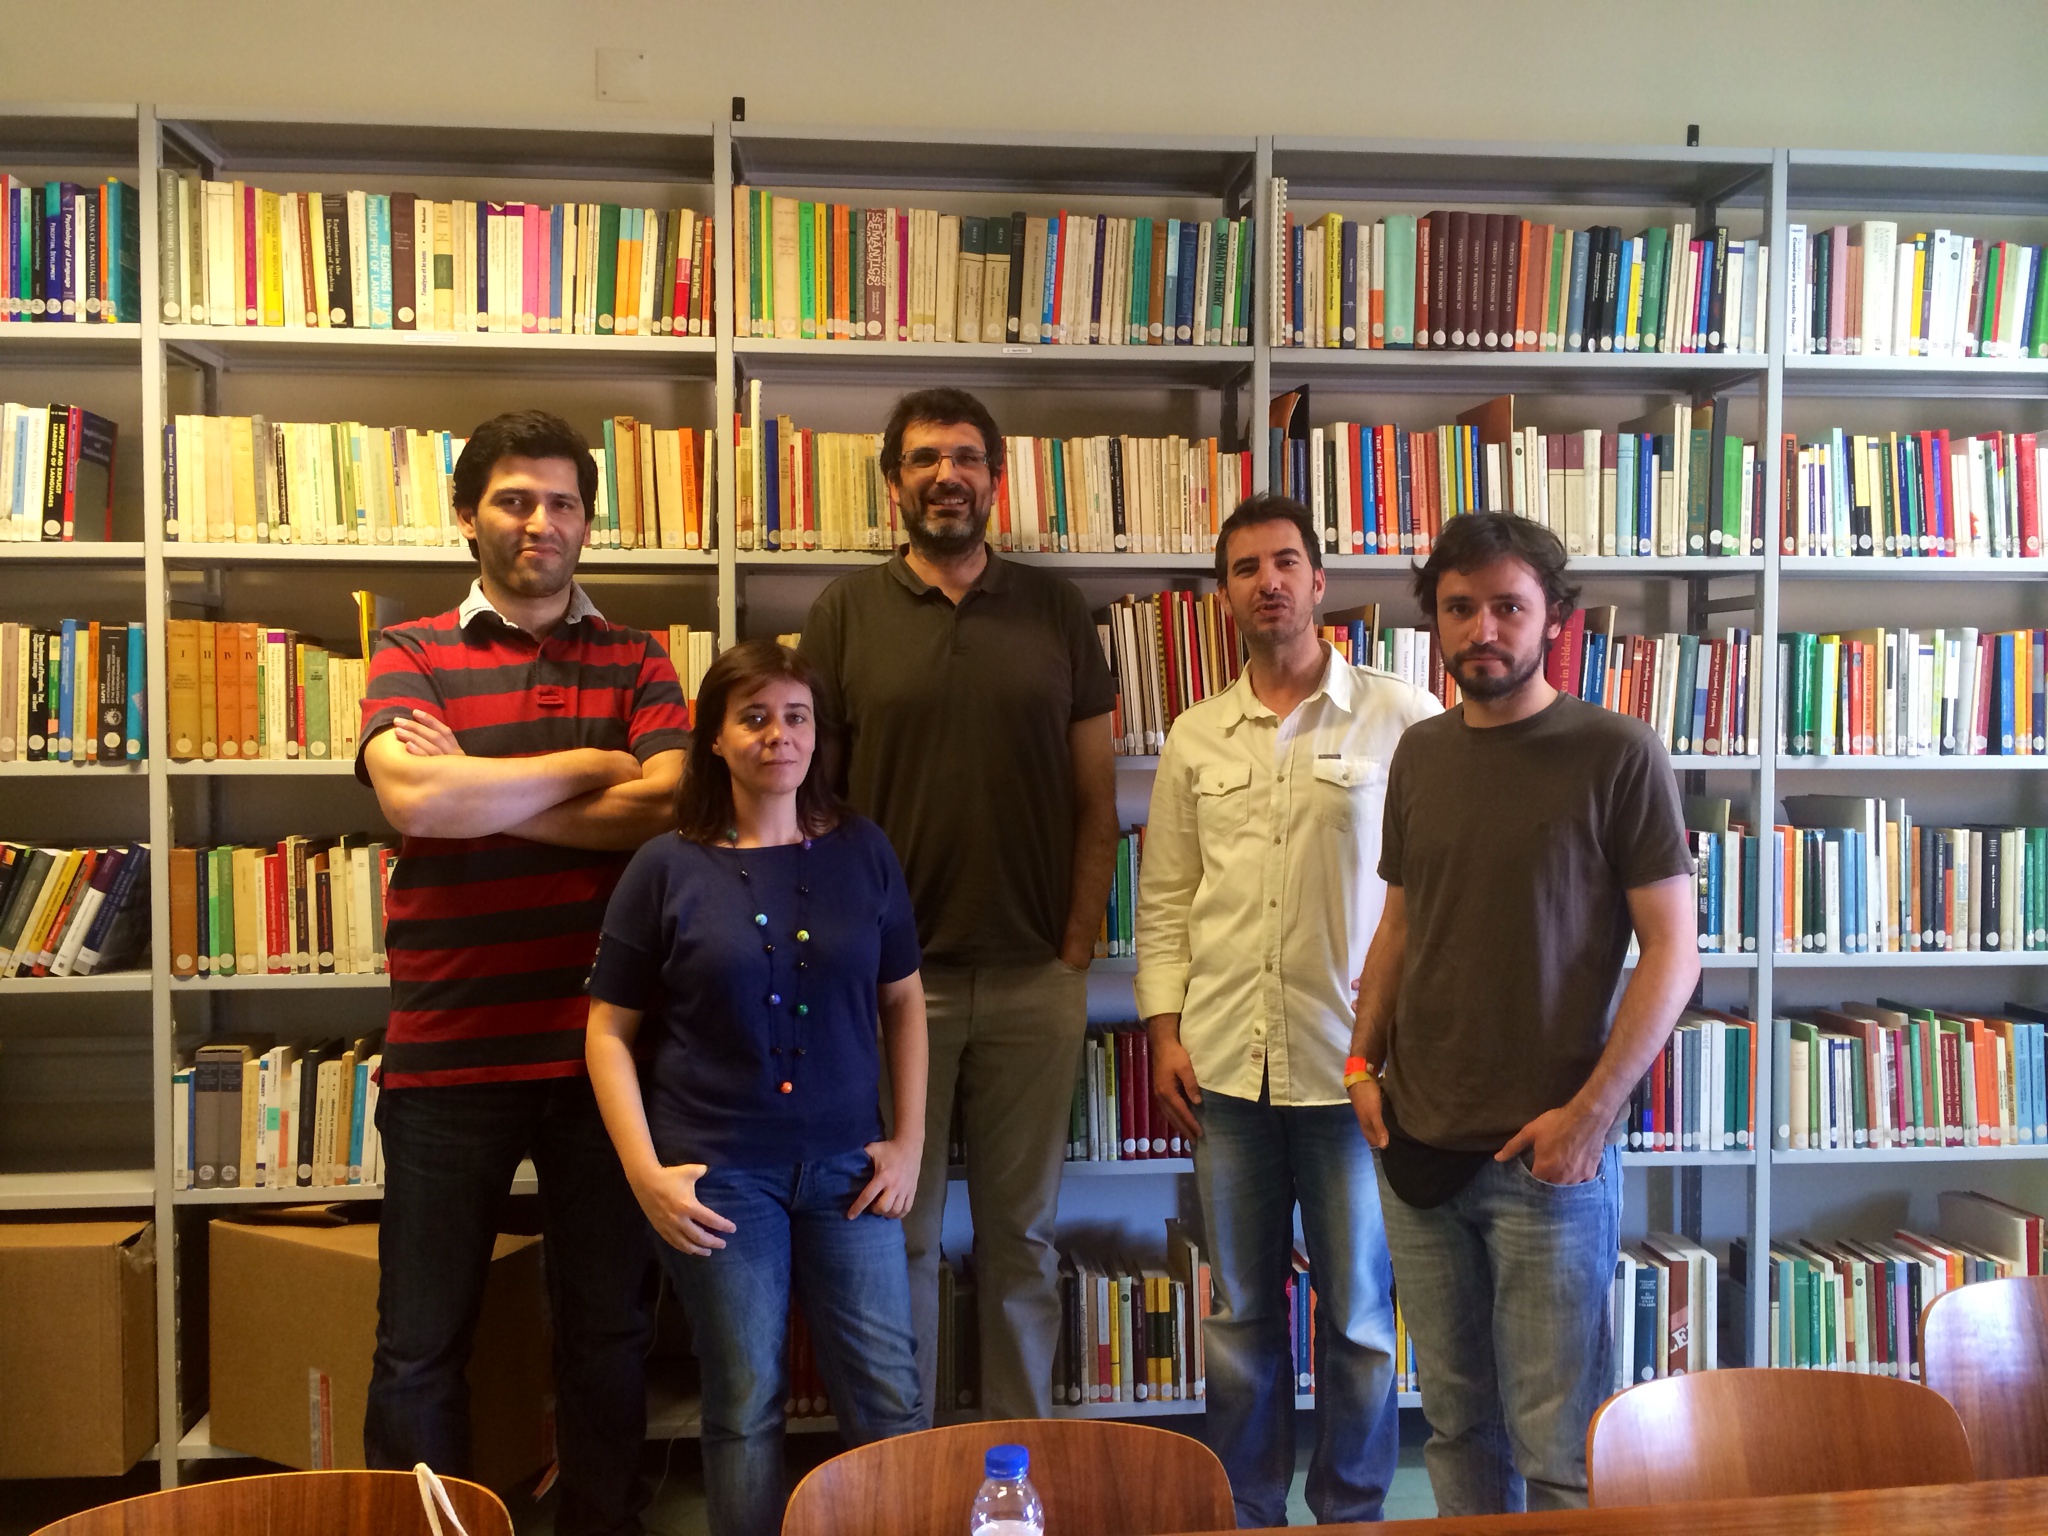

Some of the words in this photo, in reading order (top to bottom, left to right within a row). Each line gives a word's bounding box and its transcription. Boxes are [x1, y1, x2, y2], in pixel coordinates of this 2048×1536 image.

[89, 203, 97, 231] ARENAS
[694, 221, 702, 232] Ways
[89, 232, 97, 242] OF
[369, 199, 379, 257] PHILOSOPHY
[64, 250, 71, 258] of
[167, 252, 173, 260] IN
[327, 254, 335, 263] of
[872, 215, 880, 284] SEMANTICS
[1216, 232, 1228, 275] SEMANTIC
[89, 245, 97, 282] LANGUAGE
[371, 260, 379, 272] OF
[380, 245, 391, 292] READINGS
[371, 274, 380, 324] LANGUA
[382, 294, 391, 304] IN
[1213, 276, 1225, 308] THEORY
[58, 423, 66, 450] IMPLICIT
[50, 457, 57, 467] OF
[1560, 631, 1572, 667] Feldern
[1560, 670, 1569, 679] in
[1866, 722, 1872, 730] EL
